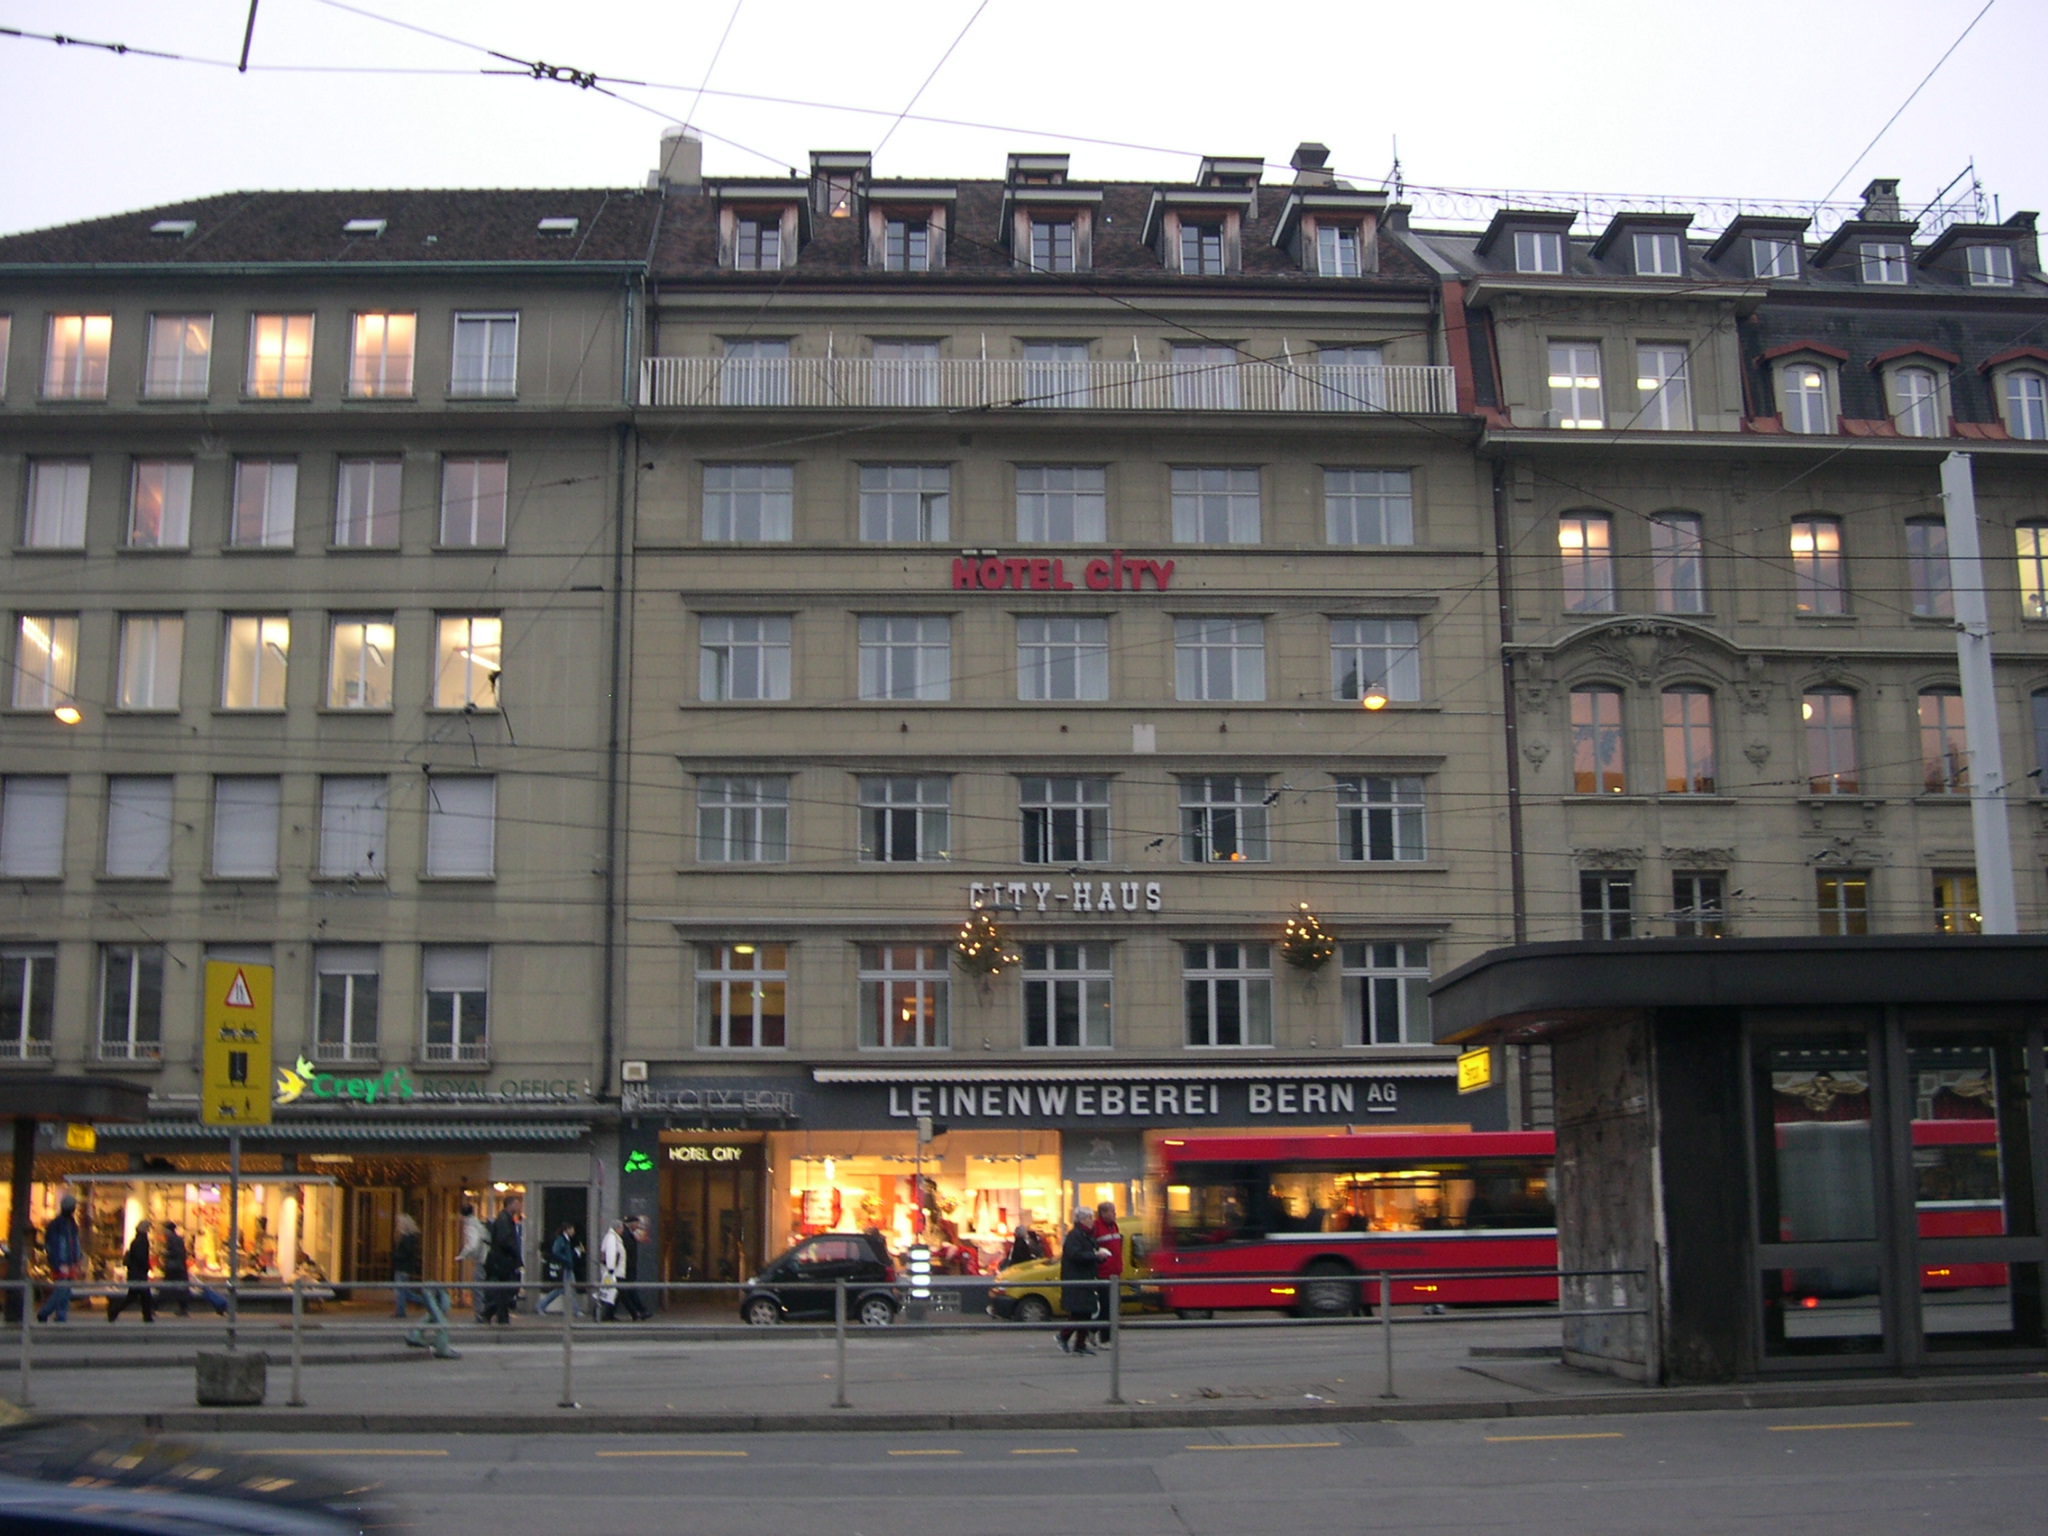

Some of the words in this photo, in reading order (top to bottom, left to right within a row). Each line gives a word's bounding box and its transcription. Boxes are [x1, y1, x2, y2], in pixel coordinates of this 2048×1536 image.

[951, 557, 1074, 591] HOTEL
[311, 1067, 413, 1103] Creyf's
[422, 1078, 488, 1098] ROYAL
[500, 1078, 579, 1098] OFFICE
[889, 1085, 1220, 1118] LEINENWEBEREI
[1248, 1083, 1355, 1115] BERN
[1367, 1082, 1398, 1103] AG
[669, 1146, 711, 1161] HOTEL
[712, 1146, 742, 1161] CITY
